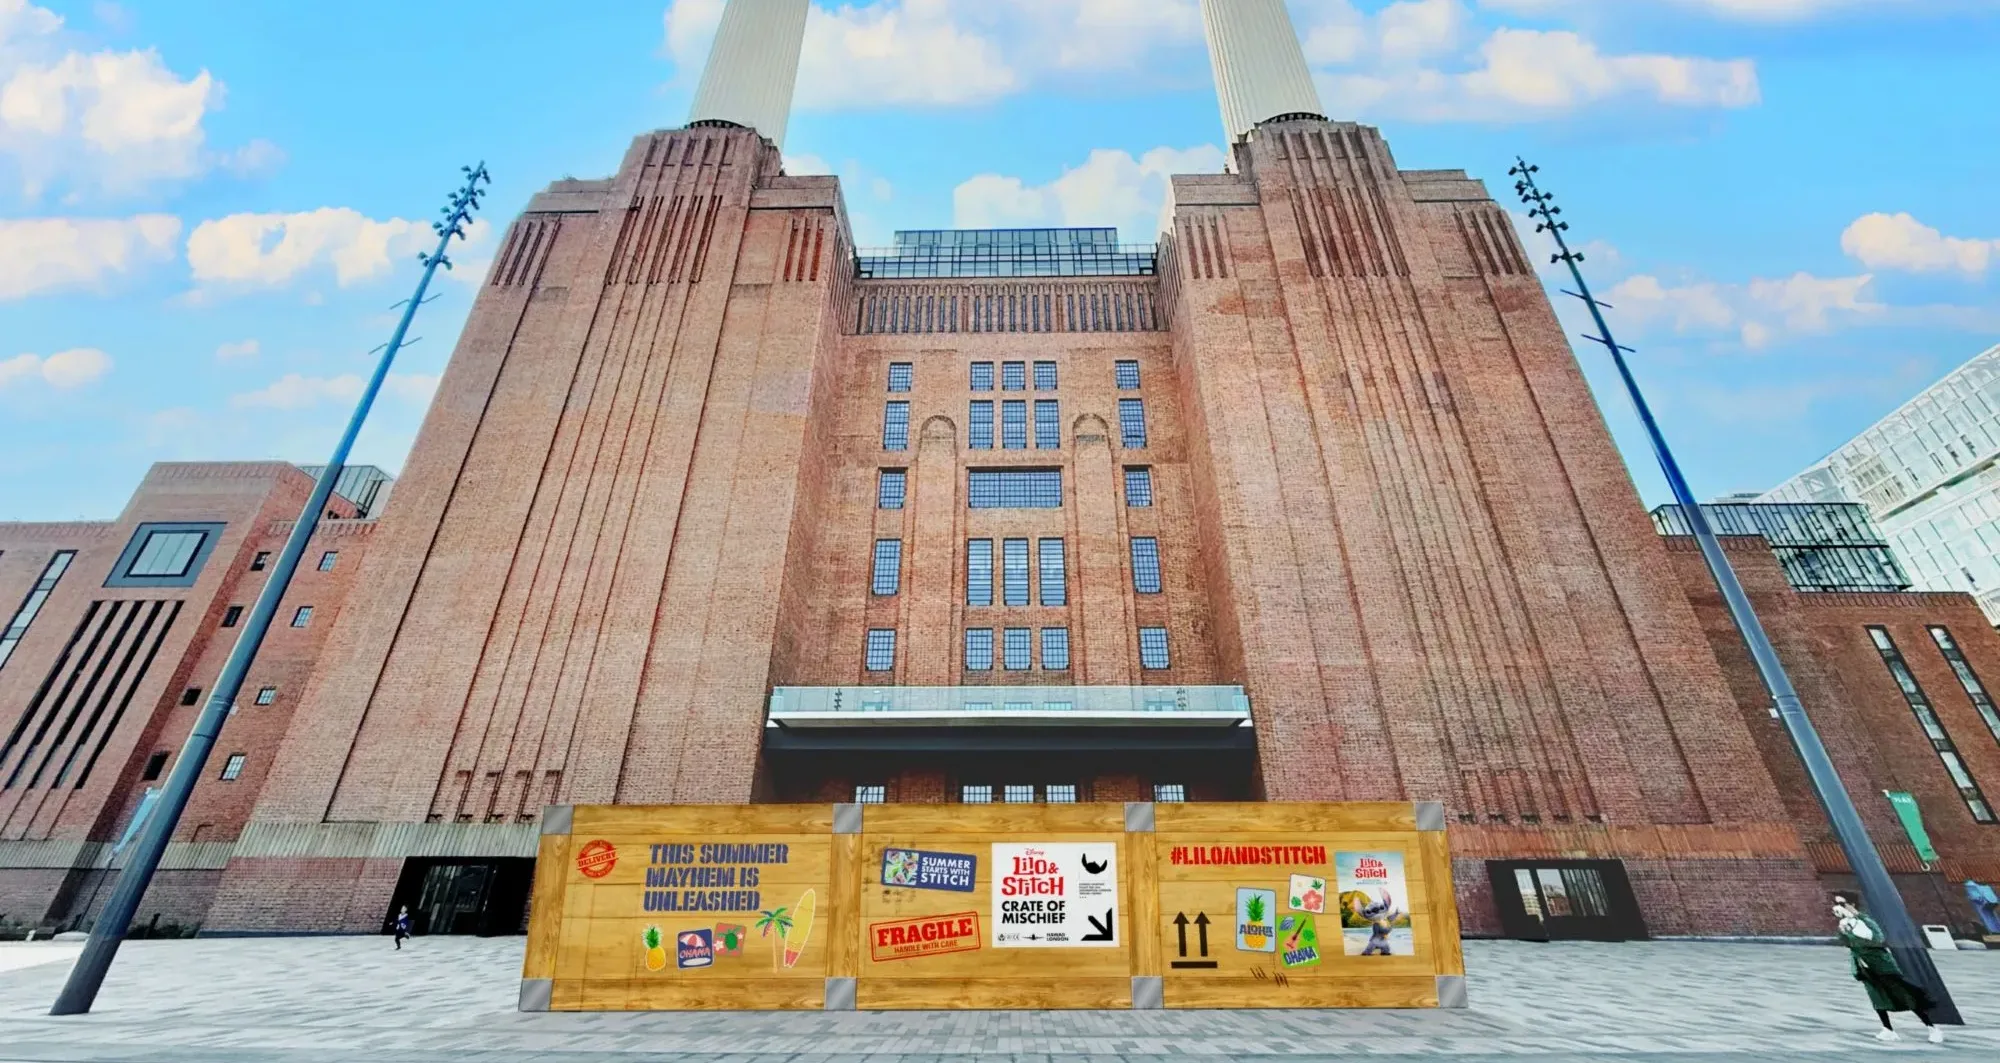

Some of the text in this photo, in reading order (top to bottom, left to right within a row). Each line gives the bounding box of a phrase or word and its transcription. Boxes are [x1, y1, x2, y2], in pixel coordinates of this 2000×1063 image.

[578, 850, 616, 868] DELIVERY
[650, 844, 789, 864] THIS SUMMER
[1170, 845, 1327, 865] #LILOANDSTITCH
[921, 857, 971, 869] SUMMER
[645, 867, 760, 887] MAYHEM IS
[921, 865, 970, 876] STARTS WITH
[920, 873, 970, 886] STITCH
[643, 891, 760, 911] UNLEASHED
[1001, 900, 1066, 912] CRATE OF
[1001, 912, 1067, 924] MISCHIEF
[877, 918, 973, 947] FRAGILE
[1239, 924, 1274, 938] ALOHA
[894, 939, 958, 953] HANDLE WITH CARE
